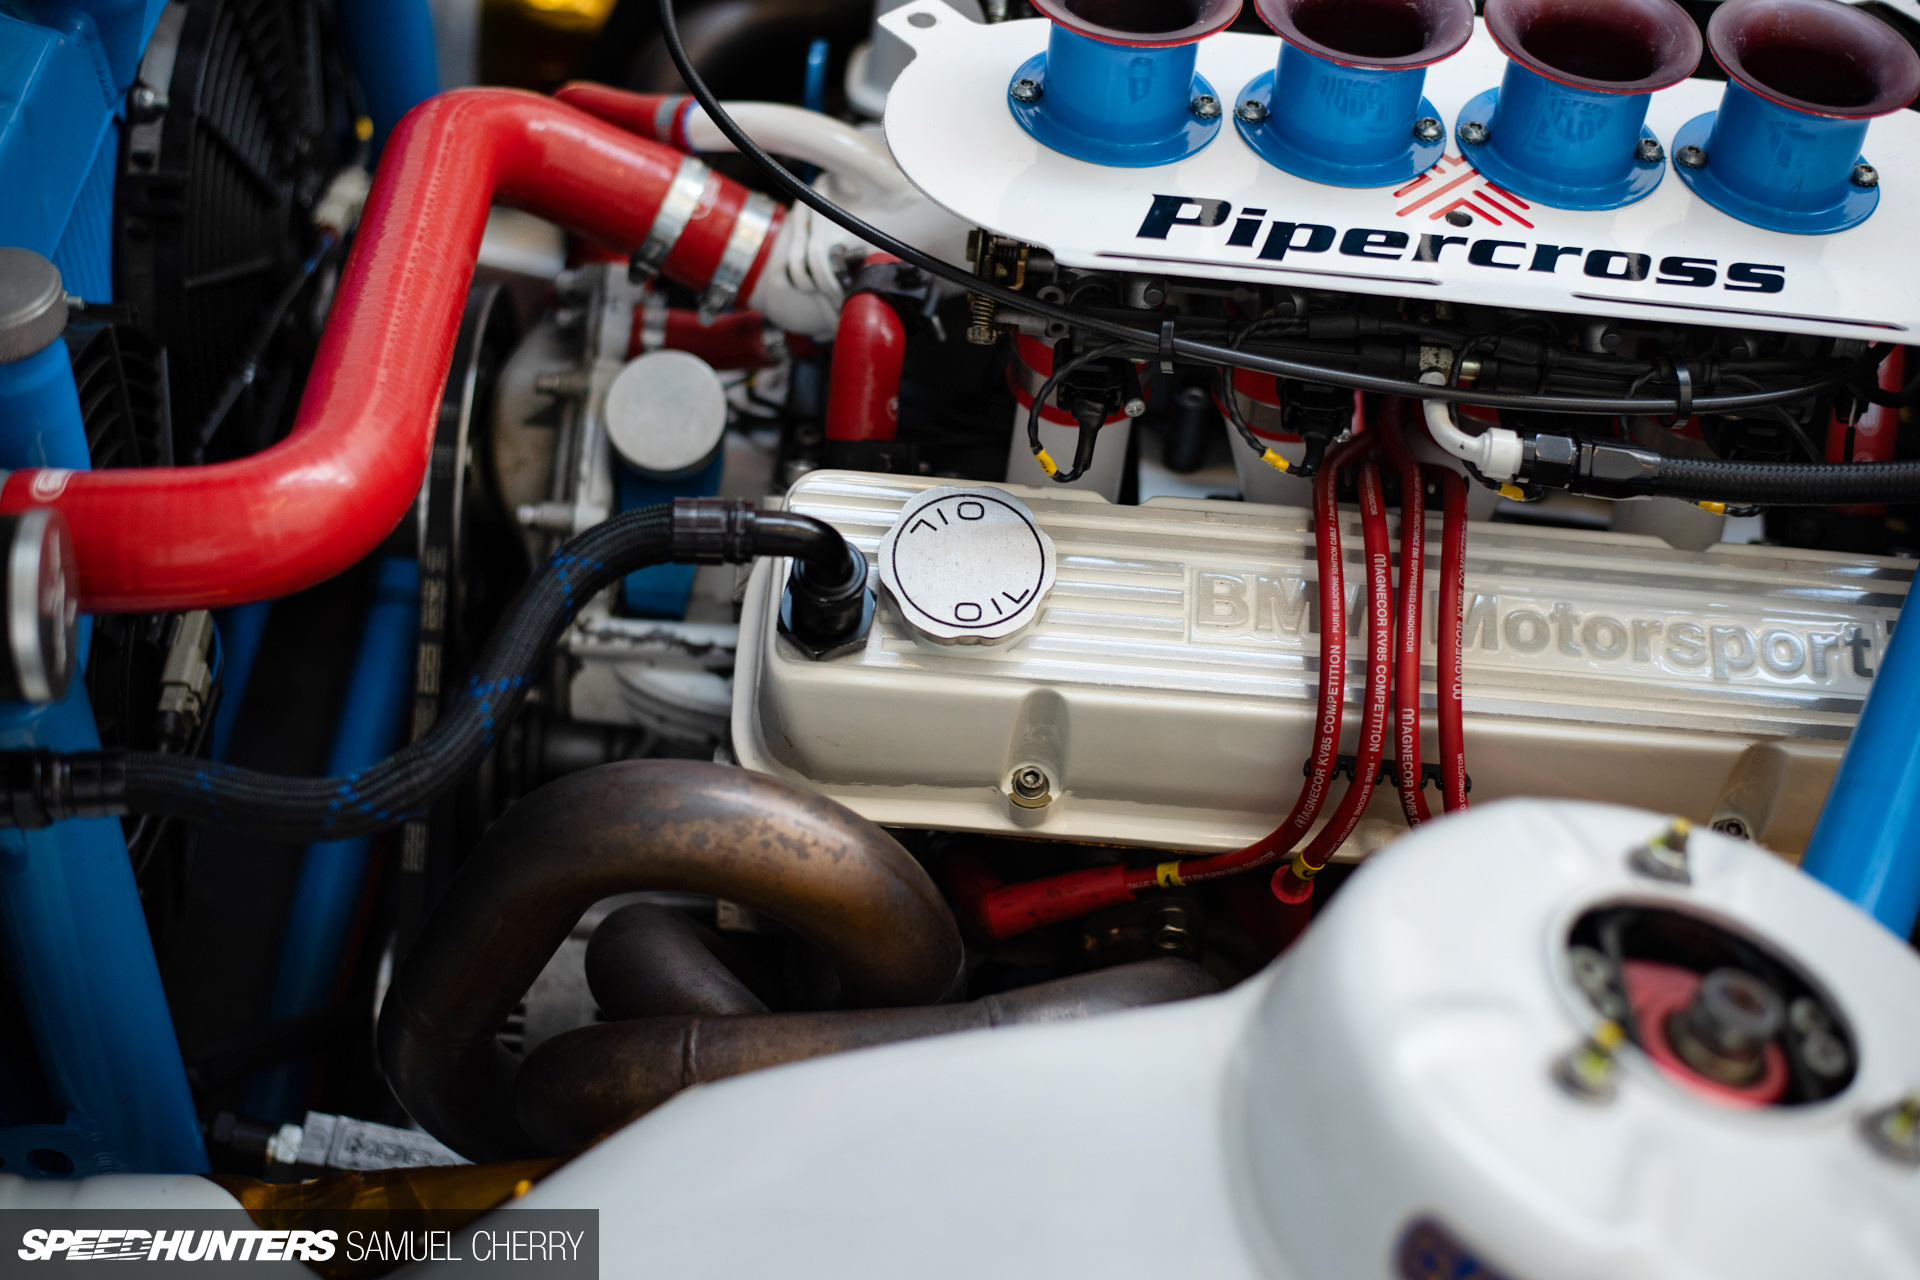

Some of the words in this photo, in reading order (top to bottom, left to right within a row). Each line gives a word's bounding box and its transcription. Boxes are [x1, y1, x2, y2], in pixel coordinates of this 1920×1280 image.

[1134, 193, 1786, 294] Pipercross
[909, 501, 985, 534] OIL
[1412, 513, 1420, 546] INDUCTANCE
[1331, 549, 1339, 576] IGNITION
[1409, 560, 1418, 604] SUPPRESSED
[954, 588, 1030, 622] OIL
[1332, 576, 1340, 610] SILICONE
[1374, 553, 1387, 626] MAGNECOR
[1332, 611, 1340, 634] PURE
[1406, 605, 1416, 653] CONDUCTOR
[1431, 589, 1874, 683] Motorsport
[1376, 630, 1388, 662] KV85
[1452, 620, 1464, 700] MAGNECOR
[1324, 644, 1341, 735] COMPETITION
[1369, 666, 1387, 752] COMPETITION
[1317, 736, 1333, 767] KV85
[1402, 708, 1415, 788] MAGNECOR
[1365, 762, 1375, 783] PURE
[1457, 753, 1466, 803] CONDUCTOR
[1294, 767, 1327, 829] MAGNECOR
[1354, 784, 1371, 816] SILICONE
[1404, 791, 1418, 816] KV85
